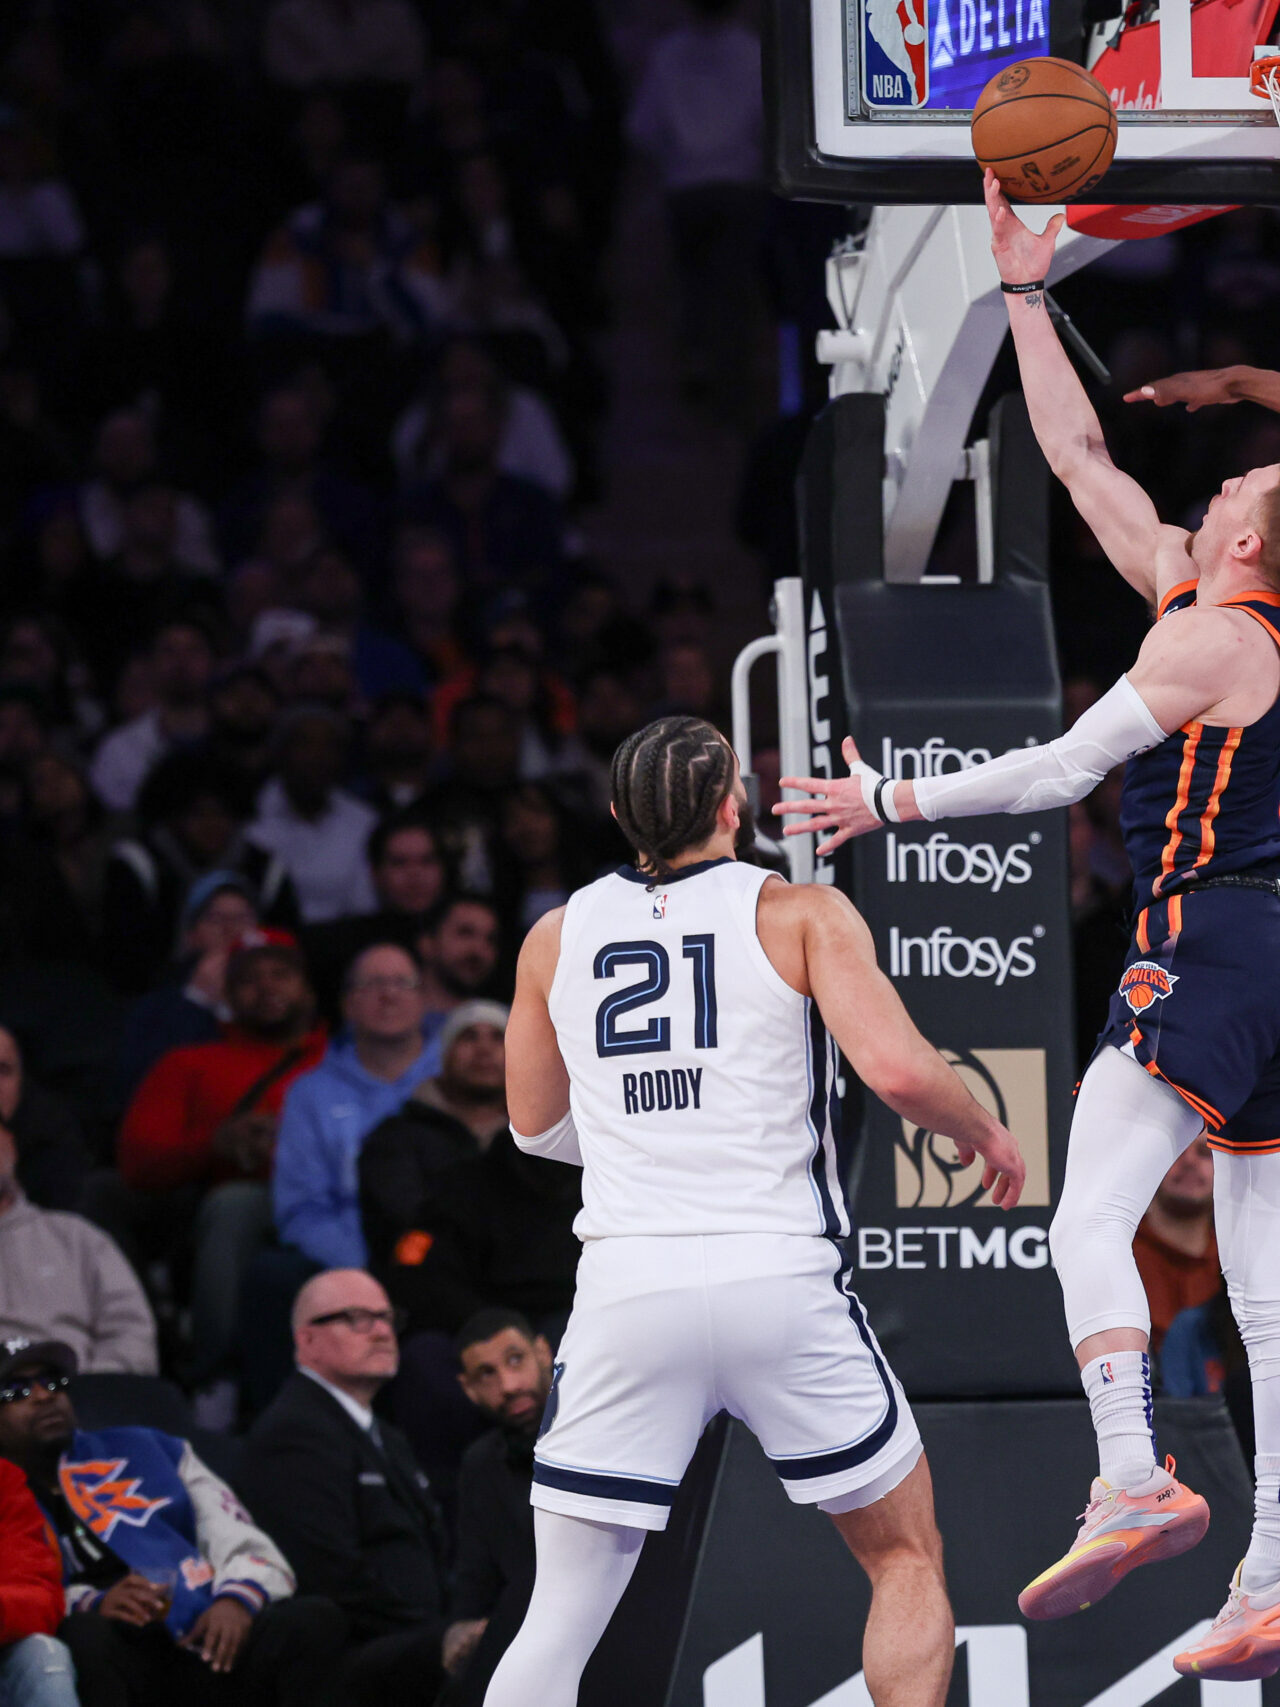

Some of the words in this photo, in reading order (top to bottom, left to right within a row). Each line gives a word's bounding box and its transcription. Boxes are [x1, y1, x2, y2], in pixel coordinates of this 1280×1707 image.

[872, 74, 904, 99] NBA
[882, 737, 1022, 780] Infos
[886, 833, 1032, 892] Infosys
[890, 926, 1037, 986] Infosys
[593, 933, 718, 1058] 21
[622, 1067, 703, 1115] RODDY
[858, 1226, 1056, 1270] BETMG
